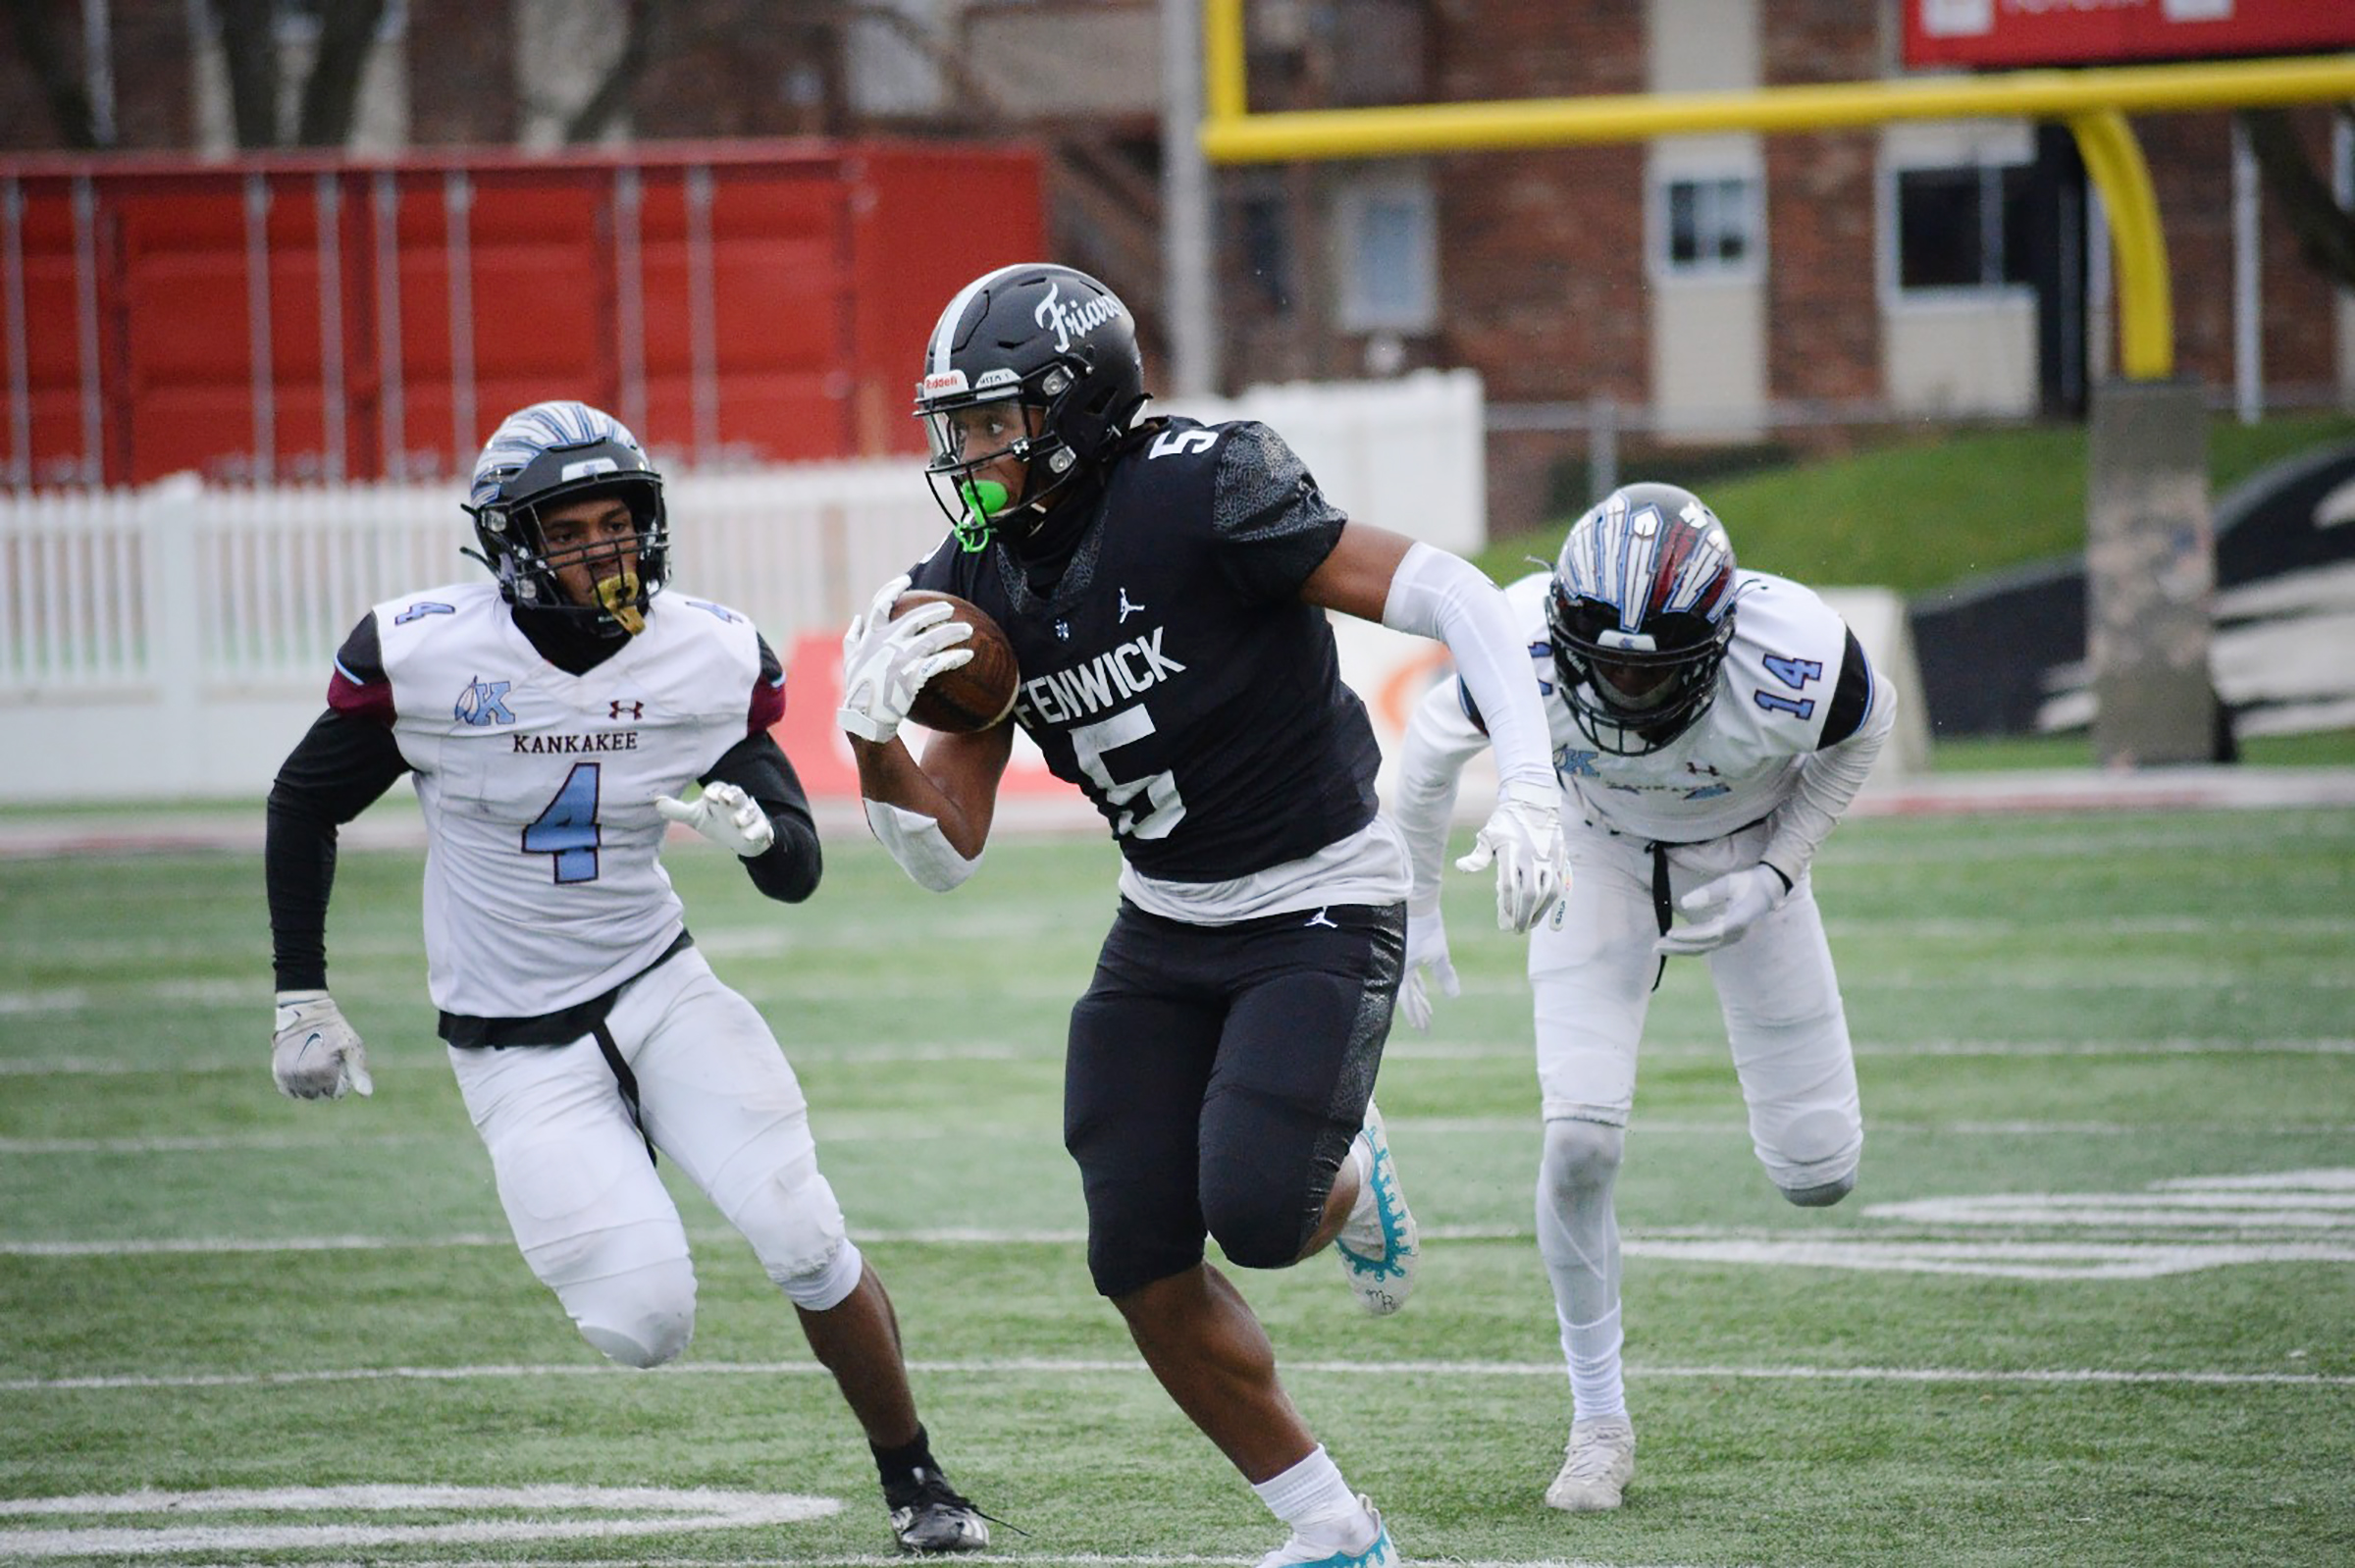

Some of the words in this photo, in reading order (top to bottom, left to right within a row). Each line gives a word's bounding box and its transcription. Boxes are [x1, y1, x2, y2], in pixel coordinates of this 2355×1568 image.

[1035, 283, 1122, 353] Friars
[1148, 430, 1219, 460] 5
[395, 601, 455, 626] 4
[1014, 626, 1187, 730] FENWICK
[1753, 653, 1822, 721] 14
[513, 732, 639, 755] KANKAKEE
[1068, 703, 1187, 840] 5
[521, 761, 601, 884] 4
